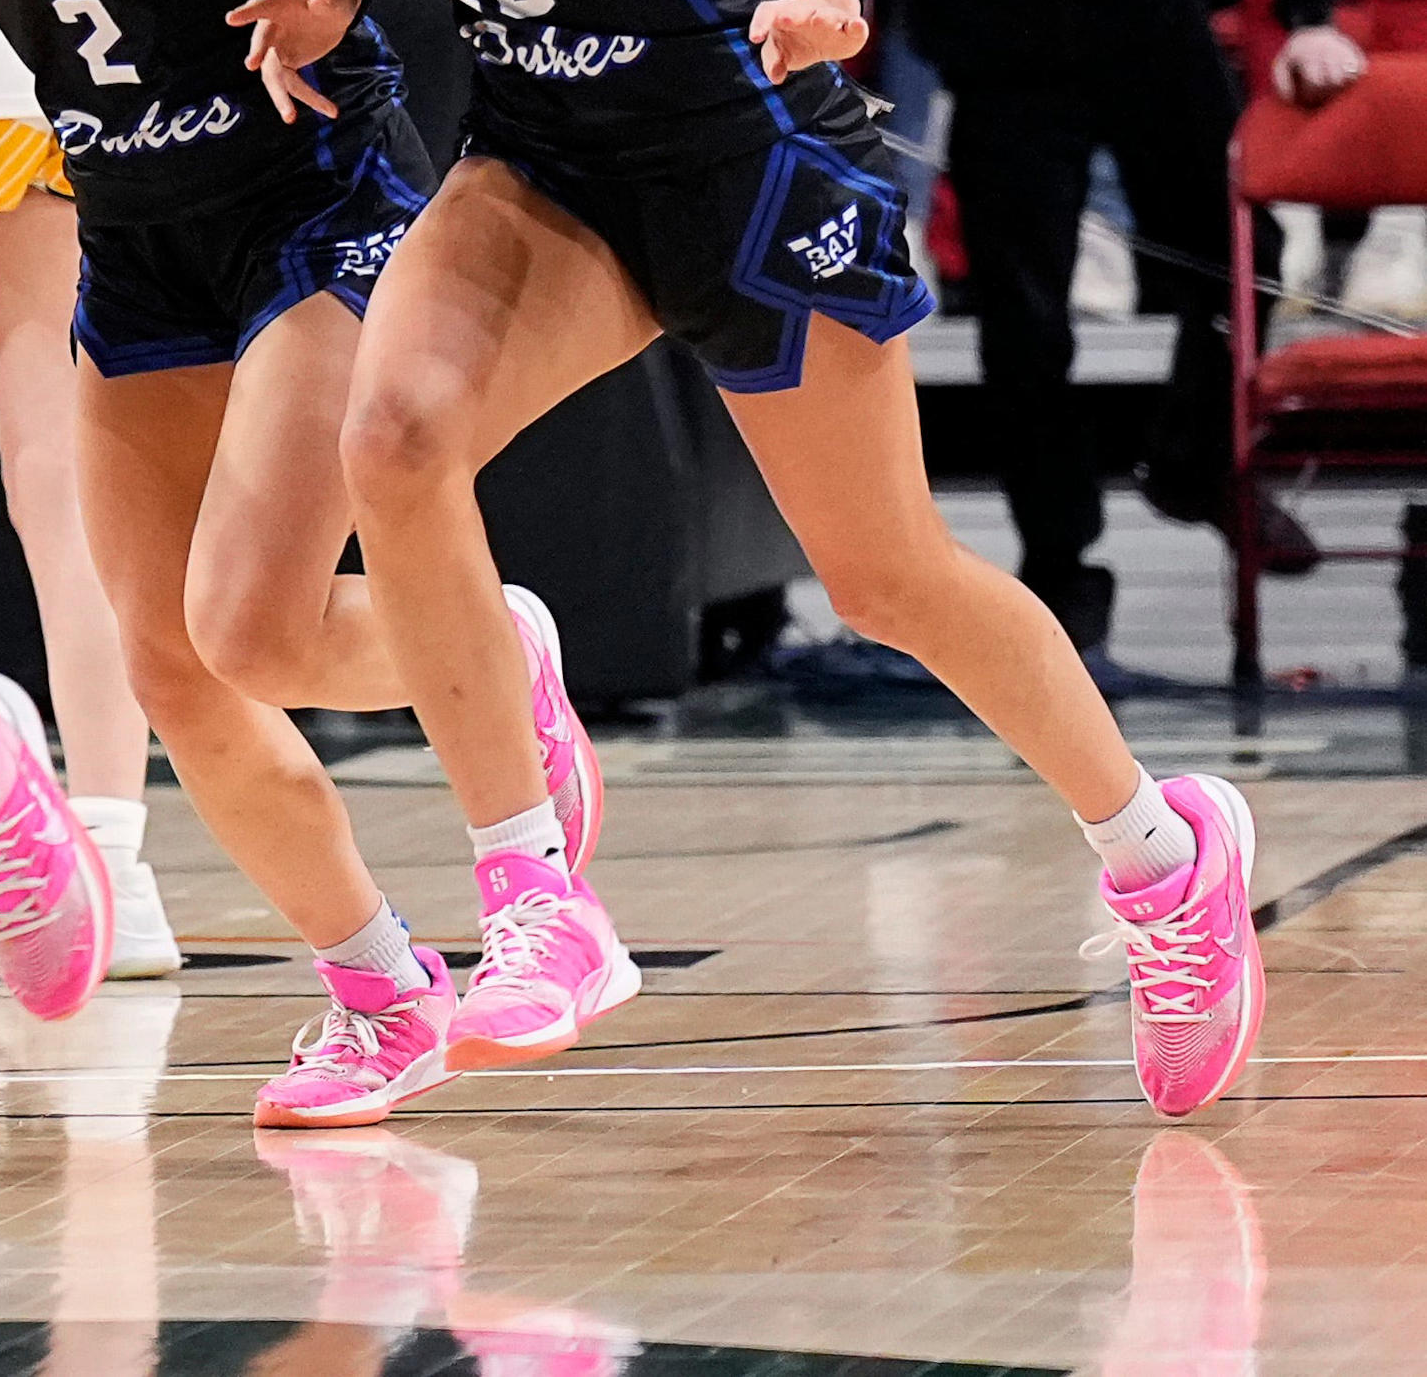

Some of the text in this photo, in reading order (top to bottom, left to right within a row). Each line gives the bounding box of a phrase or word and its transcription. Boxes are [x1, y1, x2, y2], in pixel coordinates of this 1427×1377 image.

[458, 18, 647, 78] Dukes
[52, 96, 241, 157] Dukes
[805, 221, 856, 274] BAY
